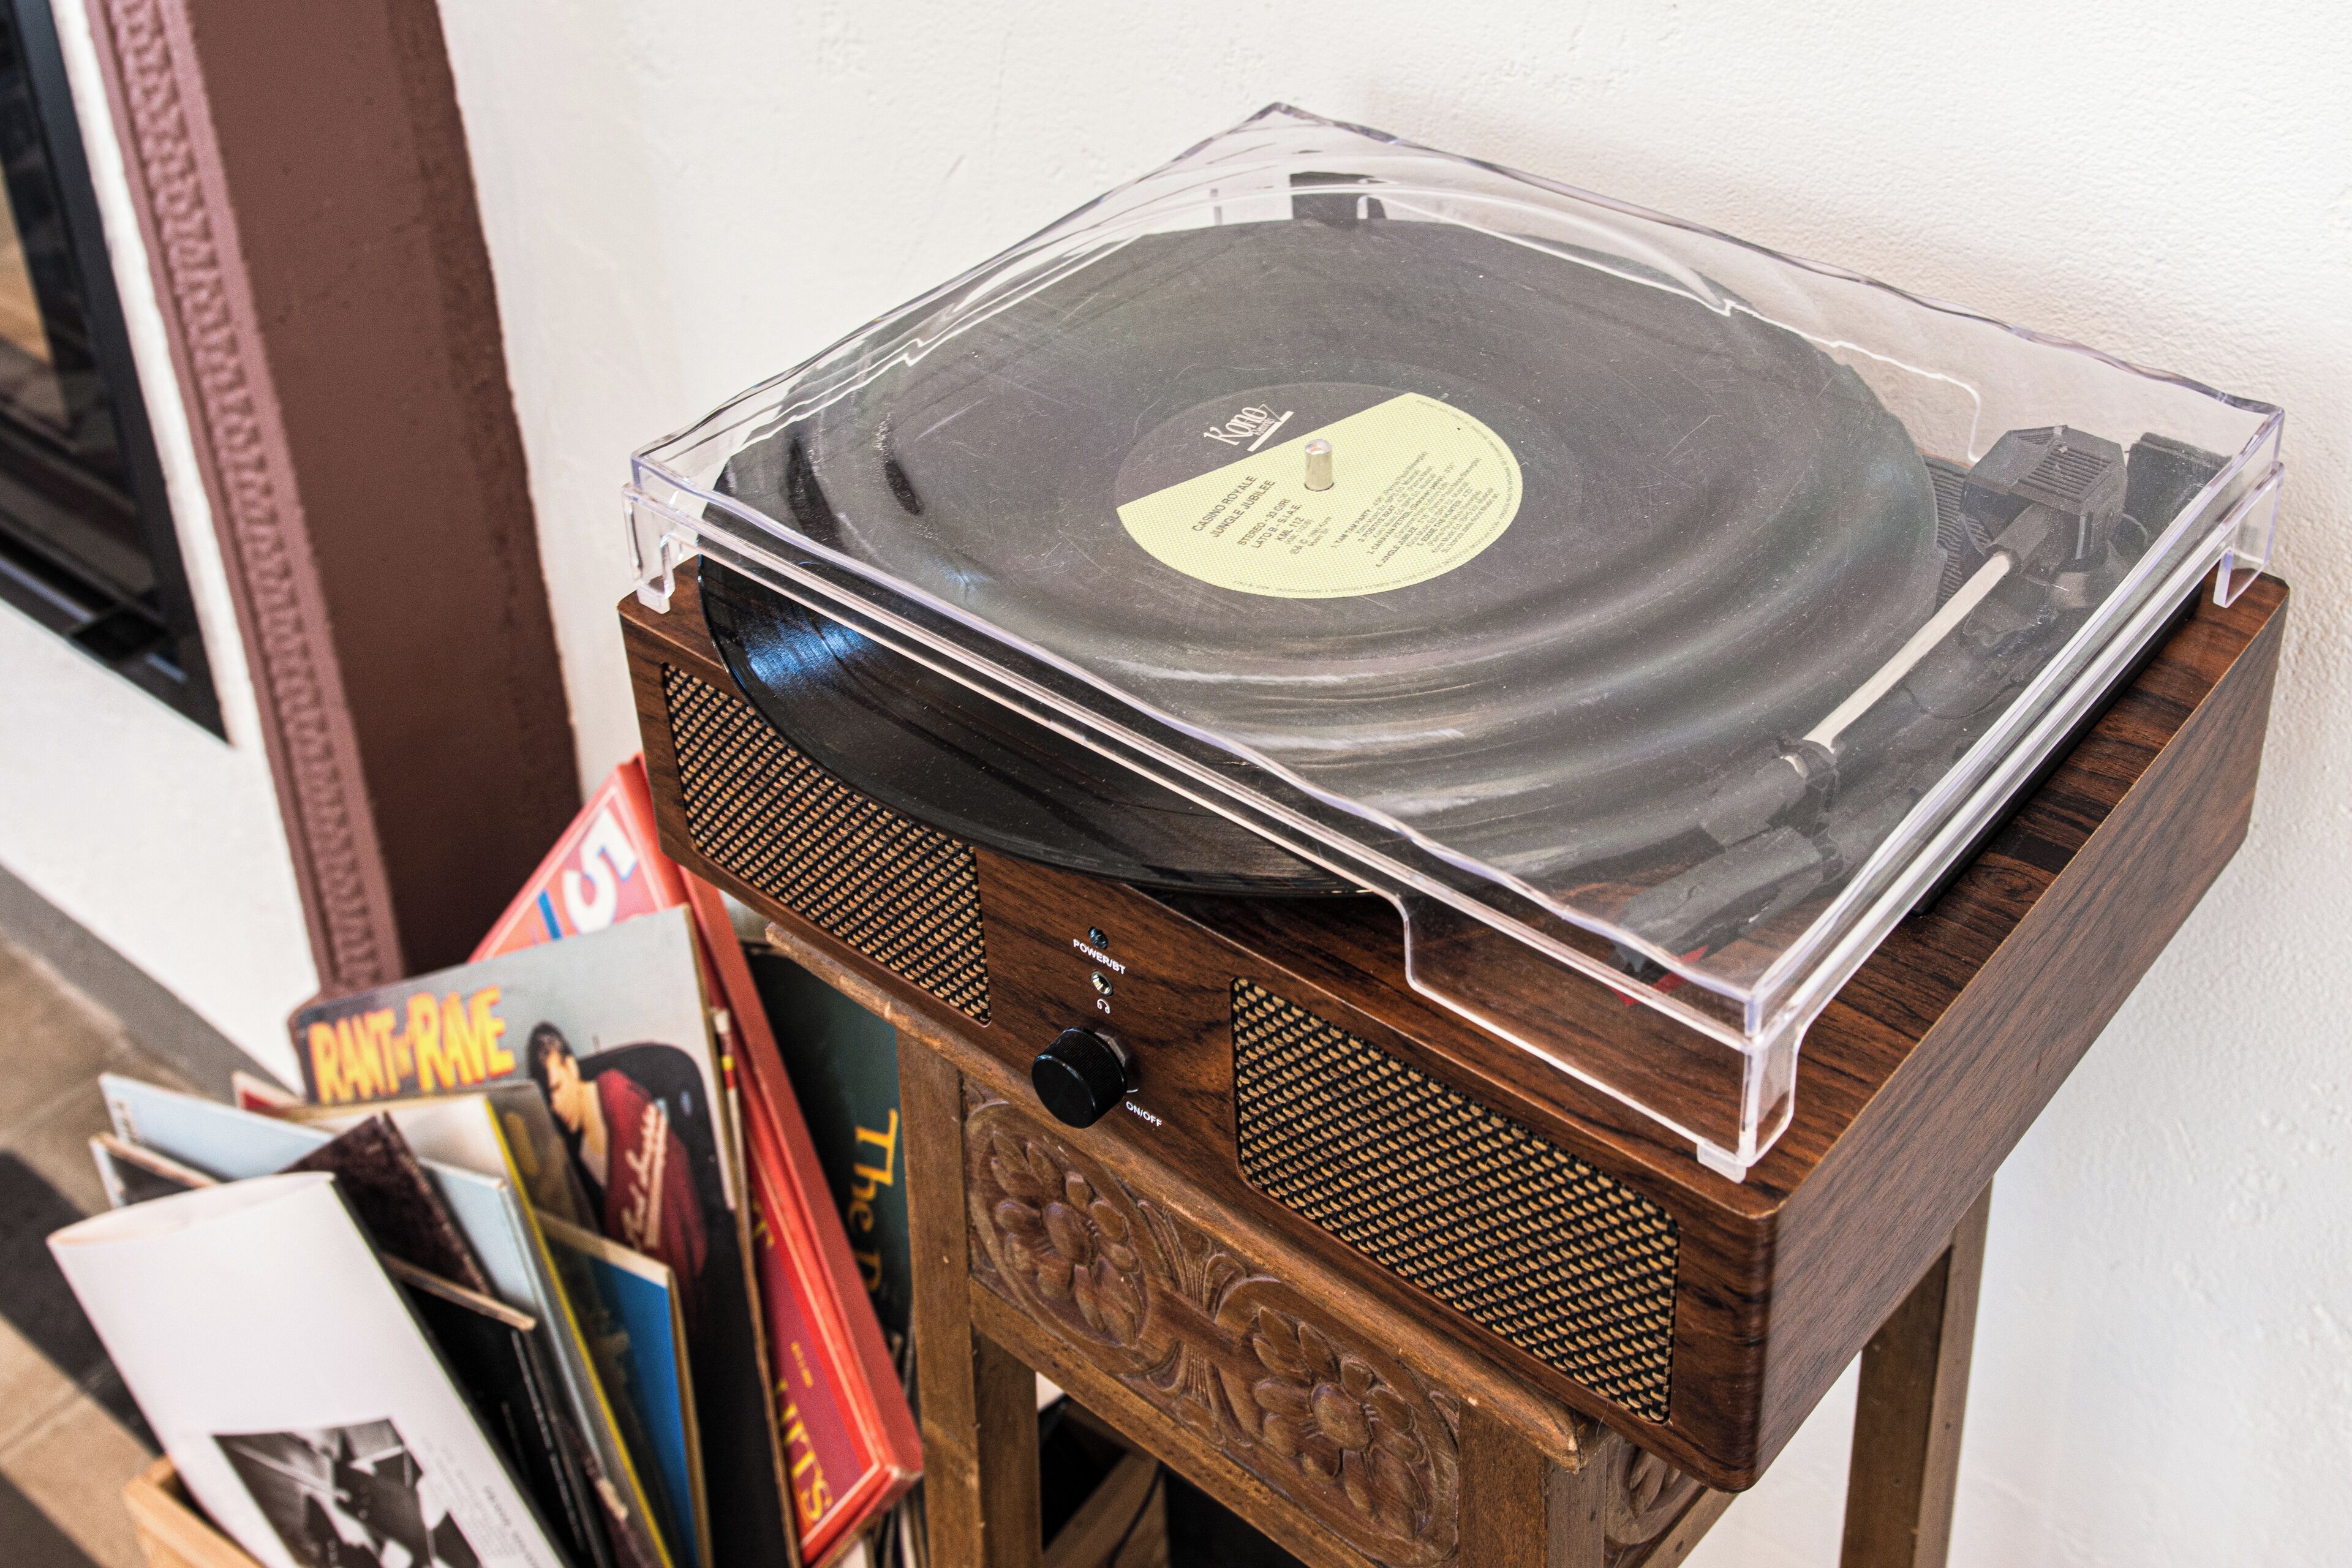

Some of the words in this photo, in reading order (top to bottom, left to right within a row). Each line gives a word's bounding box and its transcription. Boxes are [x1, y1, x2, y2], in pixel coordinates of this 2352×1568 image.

[1204, 407, 1268, 446] Kono
[1190, 503, 1227, 532] CASINO
[1221, 475, 1257, 504] ROYALE
[1207, 508, 1245, 537] JUNGLE
[1238, 480, 1276, 509] JUBILEE
[1361, 516, 1386, 537] POSITIVE
[1381, 505, 1397, 518] BEAT
[1236, 521, 1268, 545] STEREO
[1250, 532, 1273, 548] LATO
[1274, 528, 1293, 541] KML
[1288, 516, 1305, 527] 112
[1335, 533, 1348, 543] TAM
[1344, 524, 1358, 533] TAM
[1354, 508, 1372, 524] PARTY
[1369, 527, 1396, 550] CARAVAN
[1390, 509, 1413, 528] PETROL
[1378, 545, 1401, 563] JUNGLE
[1395, 526, 1419, 545] JUBILEE
[1073, 938, 1126, 974] POWER/BT
[308, 1008, 399, 1104] RANT
[405, 984, 516, 1094] RAVE
[1126, 1101, 1162, 1127] ON/OFF
[848, 1108, 898, 1232] The
